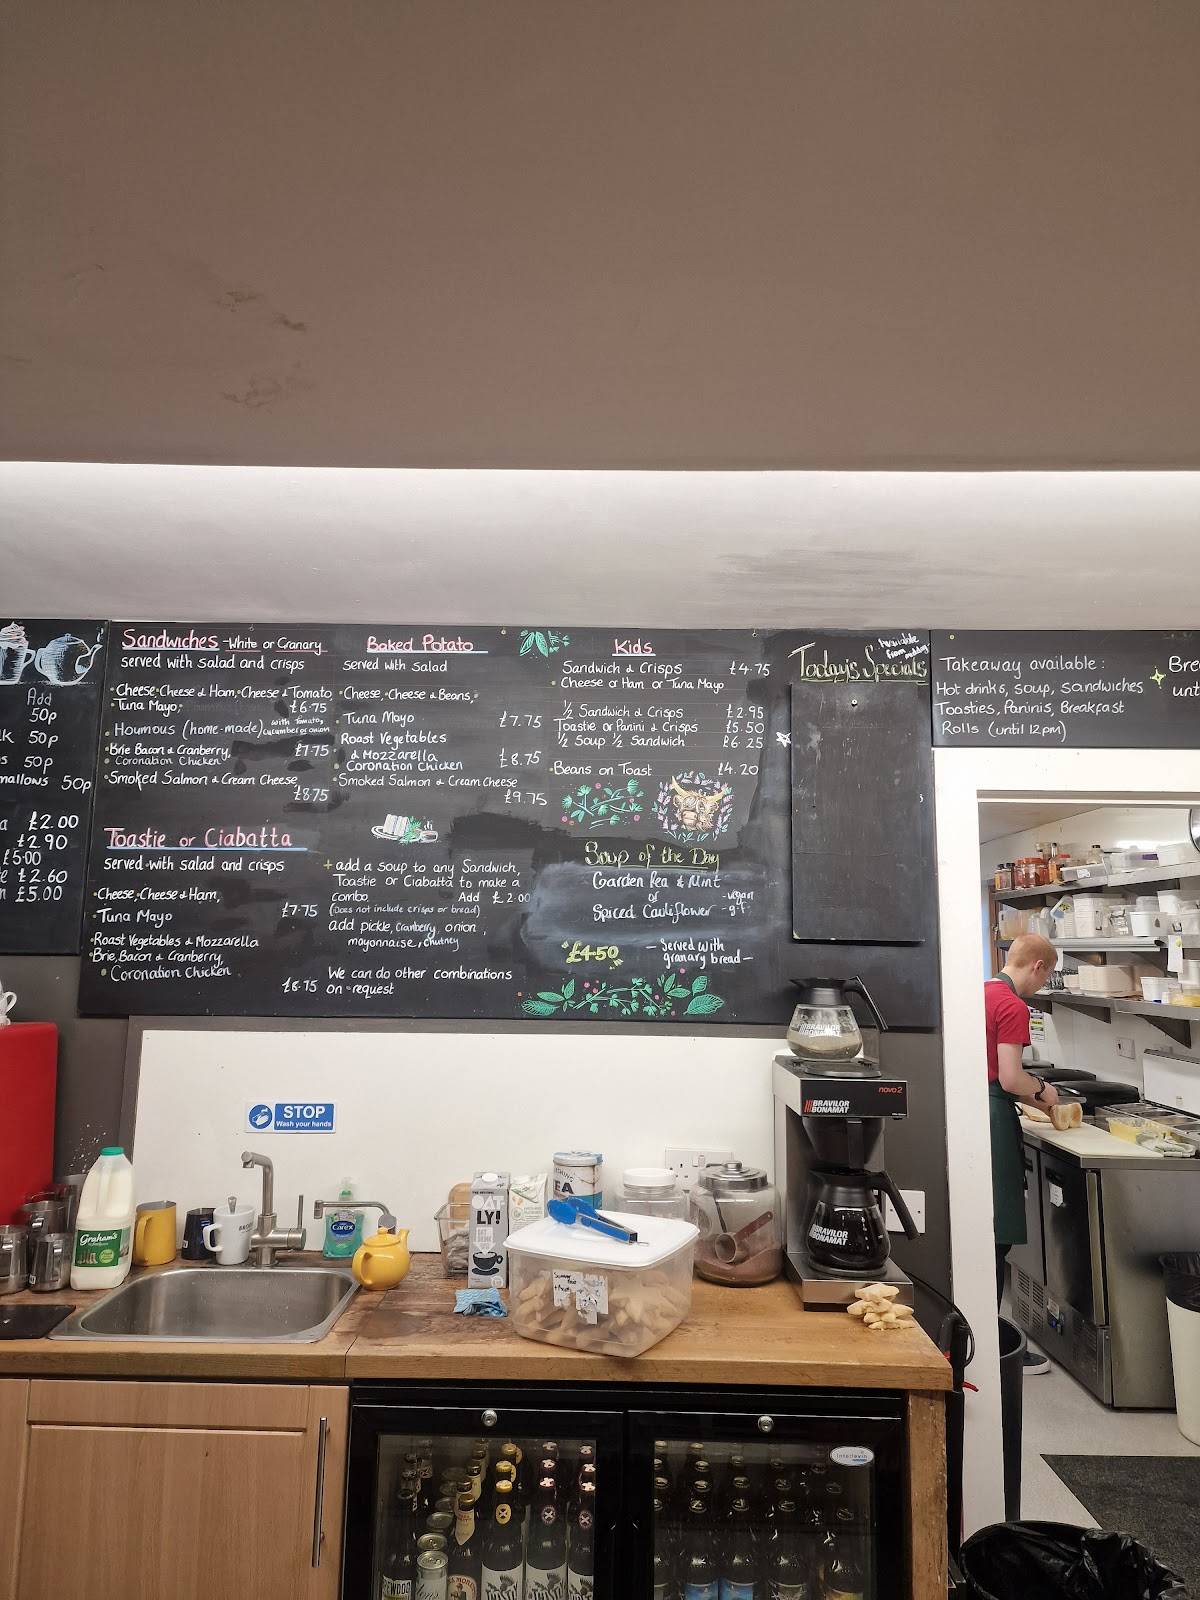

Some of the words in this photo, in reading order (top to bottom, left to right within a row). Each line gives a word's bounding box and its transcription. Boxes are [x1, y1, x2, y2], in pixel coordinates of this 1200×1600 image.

[122, 629, 220, 650] Sandwiches
[263, 641, 275, 649] or
[277, 637, 322, 655] Granary
[367, 636, 414, 652] Baked
[422, 634, 474, 652] Potato
[614, 639, 653, 655] Kids
[121, 653, 160, 668] served
[167, 655, 192, 668] with
[198, 653, 235, 669] salad
[240, 654, 264, 669] and
[270, 658, 304, 674] crisps
[343, 658, 380, 670] served
[385, 660, 406, 670] with
[412, 661, 448, 672] salad
[562, 661, 619, 674] Sandwich
[639, 662, 682, 679] Crisps
[730, 661, 770, 676] £4.75
[863, 645, 927, 682] Specials
[939, 656, 1021, 679] Takeaway
[160, 684, 195, 697] Cheese
[242, 686, 279, 698] Cheese
[561, 678, 603, 688] Cheese
[609, 680, 618, 688] or
[622, 678, 644, 689] Ham
[652, 680, 662, 688] or
[666, 678, 694, 688] Tuna
[698, 678, 724, 693] Mayo
[936, 682, 961, 695] Hot
[966, 681, 1008, 696] drinks,
[1015, 683, 1054, 696] soup,
[1060, 678, 1143, 694] sandwiches
[27, 688, 52, 706] Add
[388, 689, 425, 699] Cheese
[118, 700, 144, 710] Tuna
[579, 704, 630, 718] Sandwich
[647, 704, 683, 720] Crisps
[726, 704, 764, 719] £2.95
[936, 701, 1000, 715] Toasties,
[1004, 700, 1054, 716] Paninis,
[1060, 701, 1125, 713] Breakfast
[29, 708, 57, 725] 50p
[271, 718, 290, 726] with
[343, 713, 377, 724] Tuna
[382, 712, 415, 727] Mayo
[500, 712, 542, 728] £7.75
[114, 723, 175, 735] Houmous
[182, 720, 263, 739] (home-made)
[263, 727, 298, 736] cucumber
[553, 719, 596, 732] Toastie
[603, 723, 613, 731] or
[617, 722, 644, 732] Panini
[663, 722, 698, 738] Crisps
[725, 721, 765, 733] £5.50
[942, 721, 980, 735] Rolls
[988, 721, 1024, 738] (until
[1029, 721, 1066, 742] 12pm)
[28, 730, 58, 748] 50p
[341, 733, 373, 745] Roast
[380, 733, 446, 750] Vegetables
[574, 736, 606, 749] Soup
[631, 735, 684, 747] Sandwich
[723, 736, 763, 748] £6.25
[110, 743, 130, 755] Brie
[134, 746, 164, 755] Bacon
[295, 745, 329, 757] £7.75
[362, 751, 438, 762] Mozzarella
[24, 756, 53, 774] 50p
[116, 757, 172, 765] Coronation
[180, 757, 221, 765] Chicken
[346, 761, 412, 771] Coronation
[418, 762, 463, 771] Chicken
[500, 748, 541, 768] £8.75
[554, 761, 591, 775] Beans
[599, 766, 613, 776] on
[618, 762, 652, 776] Toast
[718, 762, 758, 776] £4.20
[62, 775, 92, 794] 50p
[108, 771, 157, 791] Smoked
[161, 773, 207, 785] Salmon
[222, 775, 255, 785] Cream
[338, 773, 384, 786] Smoked
[389, 774, 430, 787] Salmon
[449, 776, 482, 787] Cream
[483, 776, 518, 788] Cheese
[294, 788, 329, 801] £8.75
[504, 790, 547, 806] £9.75
[28, 811, 79, 831] £2.00
[17, 834, 68, 850] £2.90
[104, 828, 165, 848] Toastie
[180, 836, 195, 847] or
[204, 827, 292, 848] Ciabatta
[104, 856, 143, 870] served
[150, 856, 173, 870] with
[180, 857, 214, 871] salad
[222, 858, 242, 871] and
[249, 861, 284, 874] crisps
[585, 841, 629, 869] Soup
[639, 844, 654, 869] of
[661, 847, 684, 863] the
[689, 848, 719, 873] Day
[18, 868, 68, 884] £2.60
[336, 858, 359, 872] add
[364, 862, 372, 871] a
[377, 861, 407, 874] soup
[413, 859, 425, 872] to
[433, 863, 454, 879] any
[333, 874, 376, 886] Toastie
[404, 876, 453, 887] Ciabatta
[460, 878, 472, 888] to
[479, 877, 507, 888] make
[512, 878, 520, 887] a
[593, 871, 644, 889] Garden
[650, 872, 668, 888] Pea
[688, 875, 722, 888] Mint
[15, 886, 63, 902] £5.00
[139, 888, 180, 900] Cheese
[458, 892, 480, 902] Add
[648, 891, 659, 903] or
[97, 907, 130, 923] Tuna
[137, 910, 172, 928] Mayo
[282, 902, 318, 918] £7.75
[374, 904, 403, 913] include
[408, 905, 433, 914] crisps
[452, 905, 480, 917] bread)
[593, 904, 636, 921] Spiced
[643, 902, 717, 924] Cauliflower
[329, 918, 354, 932] add
[94, 932, 125, 945] Roast
[129, 934, 180, 950] Vegetables
[196, 936, 259, 948] Mozzarella
[660, 938, 695, 952] Served
[699, 938, 724, 951] with
[566, 941, 619, 963] £4.50
[664, 952, 706, 968] granary
[110, 965, 181, 981] Coronation
[185, 967, 231, 978] Chicken
[328, 967, 345, 979] We
[351, 969, 372, 979] can
[376, 967, 390, 979] do
[395, 968, 426, 978] other
[434, 966, 512, 980] combinations
[326, 985, 342, 994] on
[353, 984, 394, 998] request
[283, 1106, 325, 1119] STOP
[477, 1210, 500, 1224] LY!
[80, 1232, 118, 1246] Graham's
